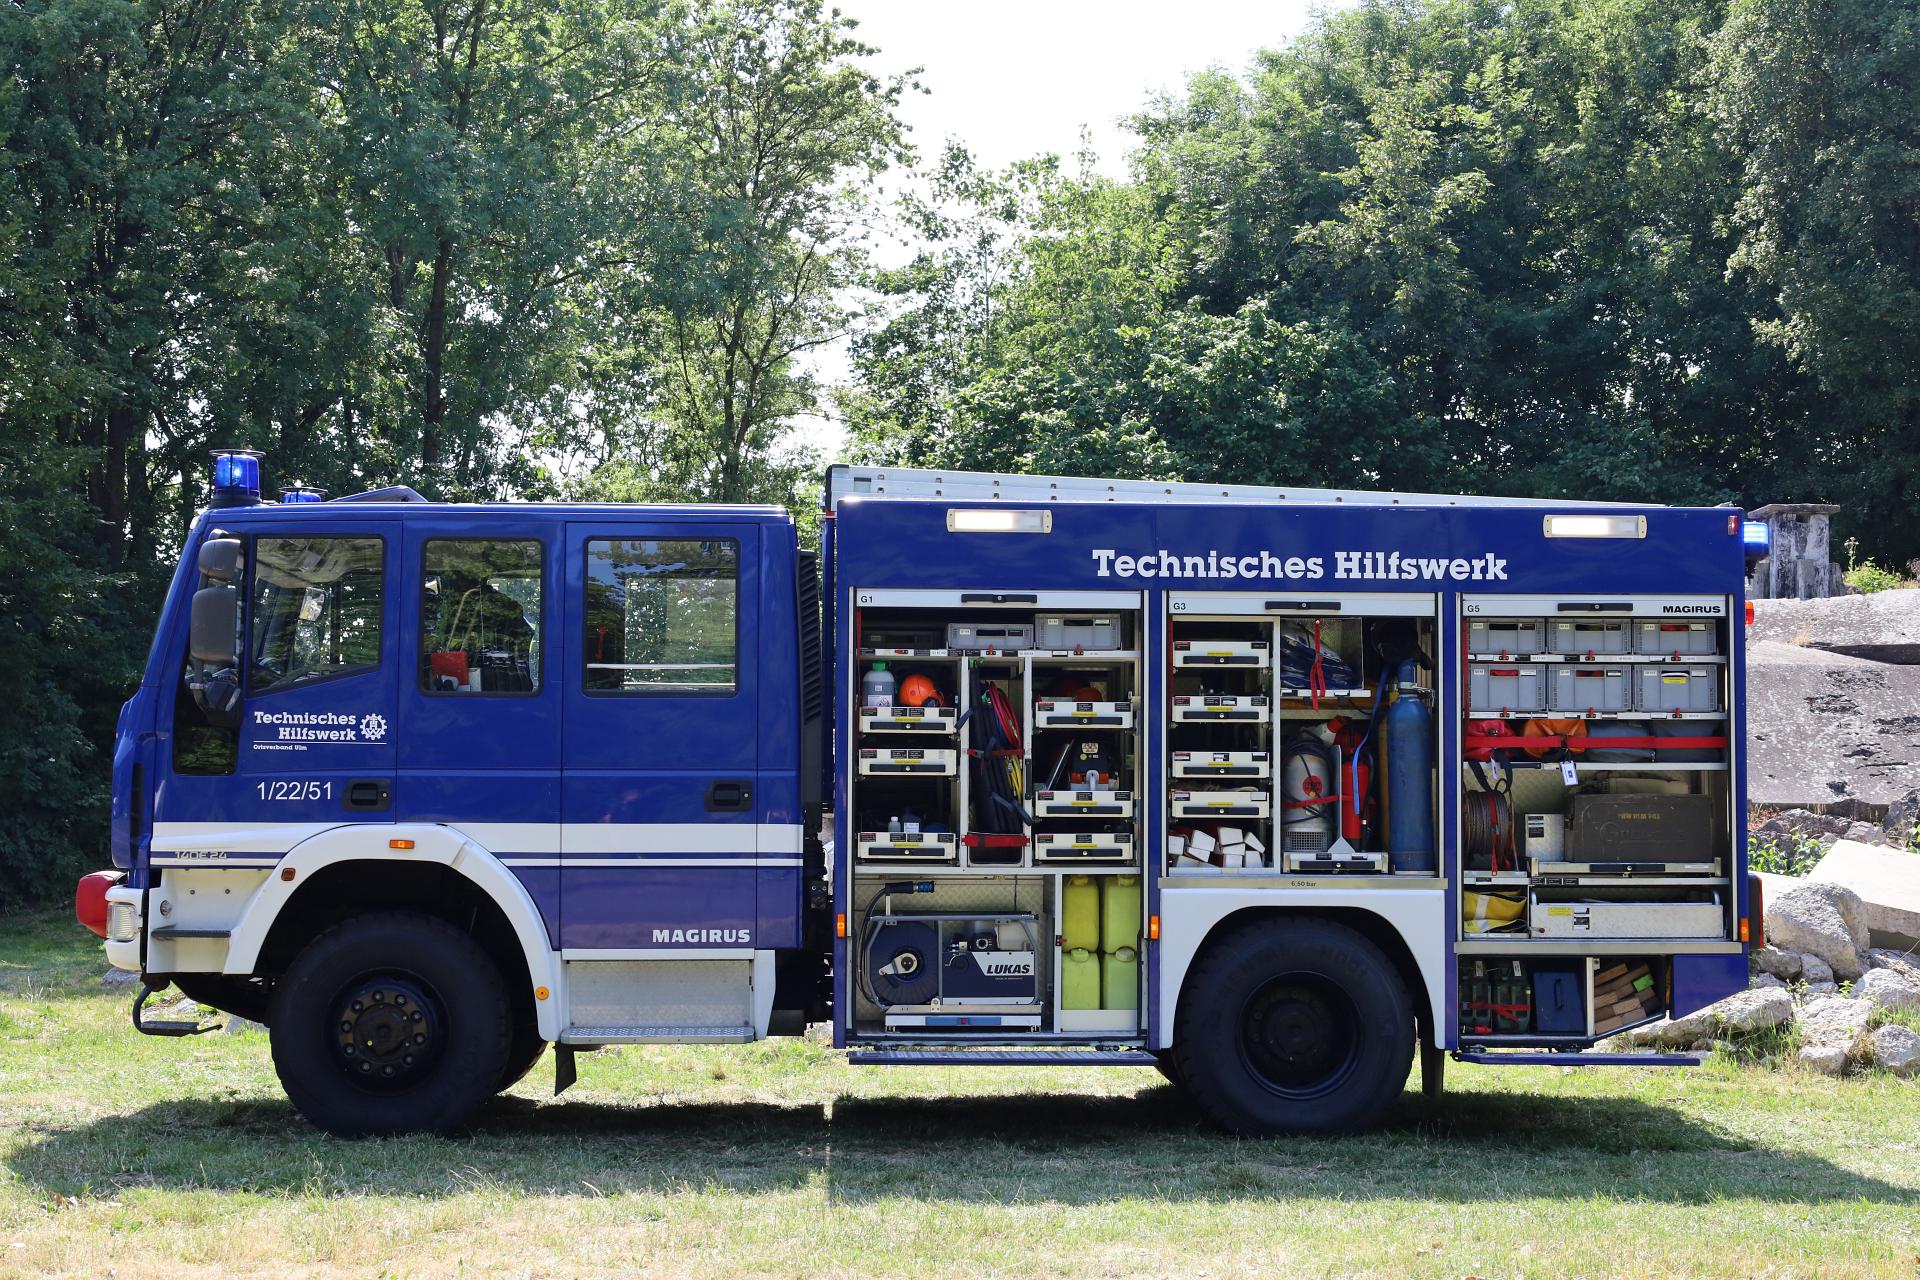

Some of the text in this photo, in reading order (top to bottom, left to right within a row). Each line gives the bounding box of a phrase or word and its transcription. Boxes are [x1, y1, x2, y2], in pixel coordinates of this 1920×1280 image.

[1092, 549, 1508, 581] Technisches Hilfswerk
[860, 595, 873, 604] G1
[1173, 602, 1187, 611] G3
[1467, 604, 1480, 613] G5
[1662, 605, 1721, 614] MAGIRUS
[254, 711, 357, 725] Technisches
[278, 727, 356, 741] Hilfswerk
[257, 781, 331, 801] 1/22/51
[652, 929, 751, 943] MAGIRUS
[986, 964, 1031, 975] LUKAS
